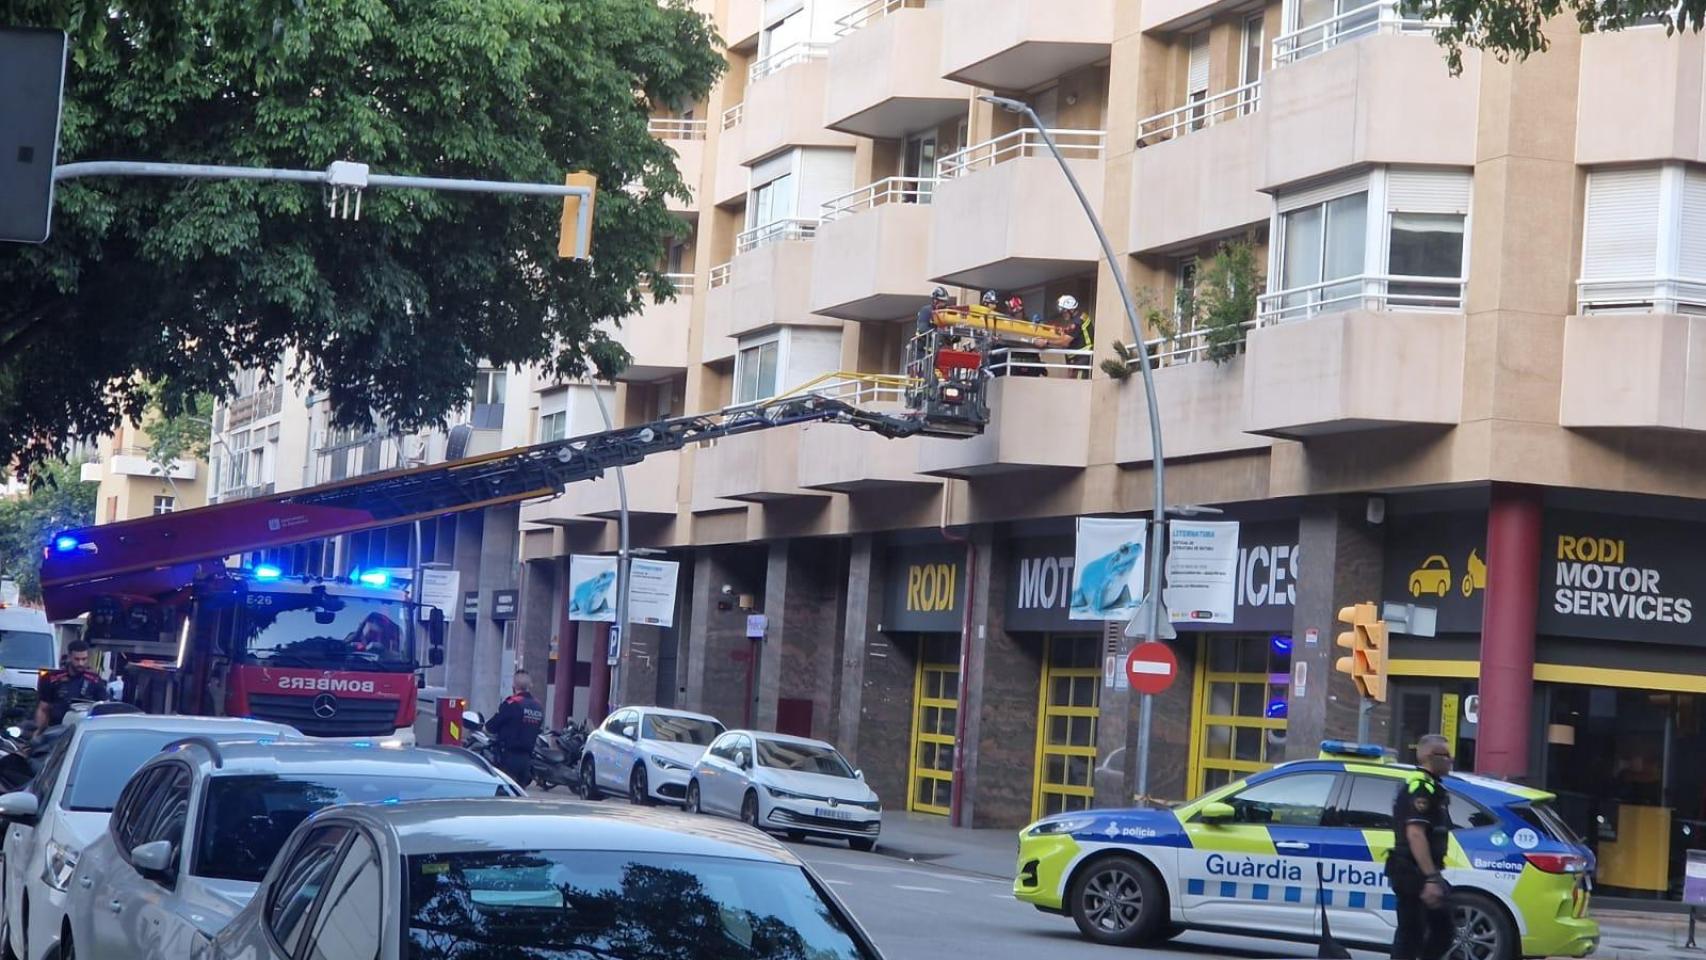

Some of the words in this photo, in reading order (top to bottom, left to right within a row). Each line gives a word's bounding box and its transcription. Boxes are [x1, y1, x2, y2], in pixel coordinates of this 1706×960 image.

[1558, 535, 1625, 564] RODI
[906, 563, 956, 612] RODI
[1018, 556, 1076, 609] MOT
[1556, 561, 1660, 594] MOTOR
[1554, 588, 1692, 624] SERVICES
[610, 630, 618, 655] P
[1206, 853, 1302, 881] Guàrdia
[1319, 862, 1394, 887] Urban
[1474, 858, 1523, 871] Barcelona
